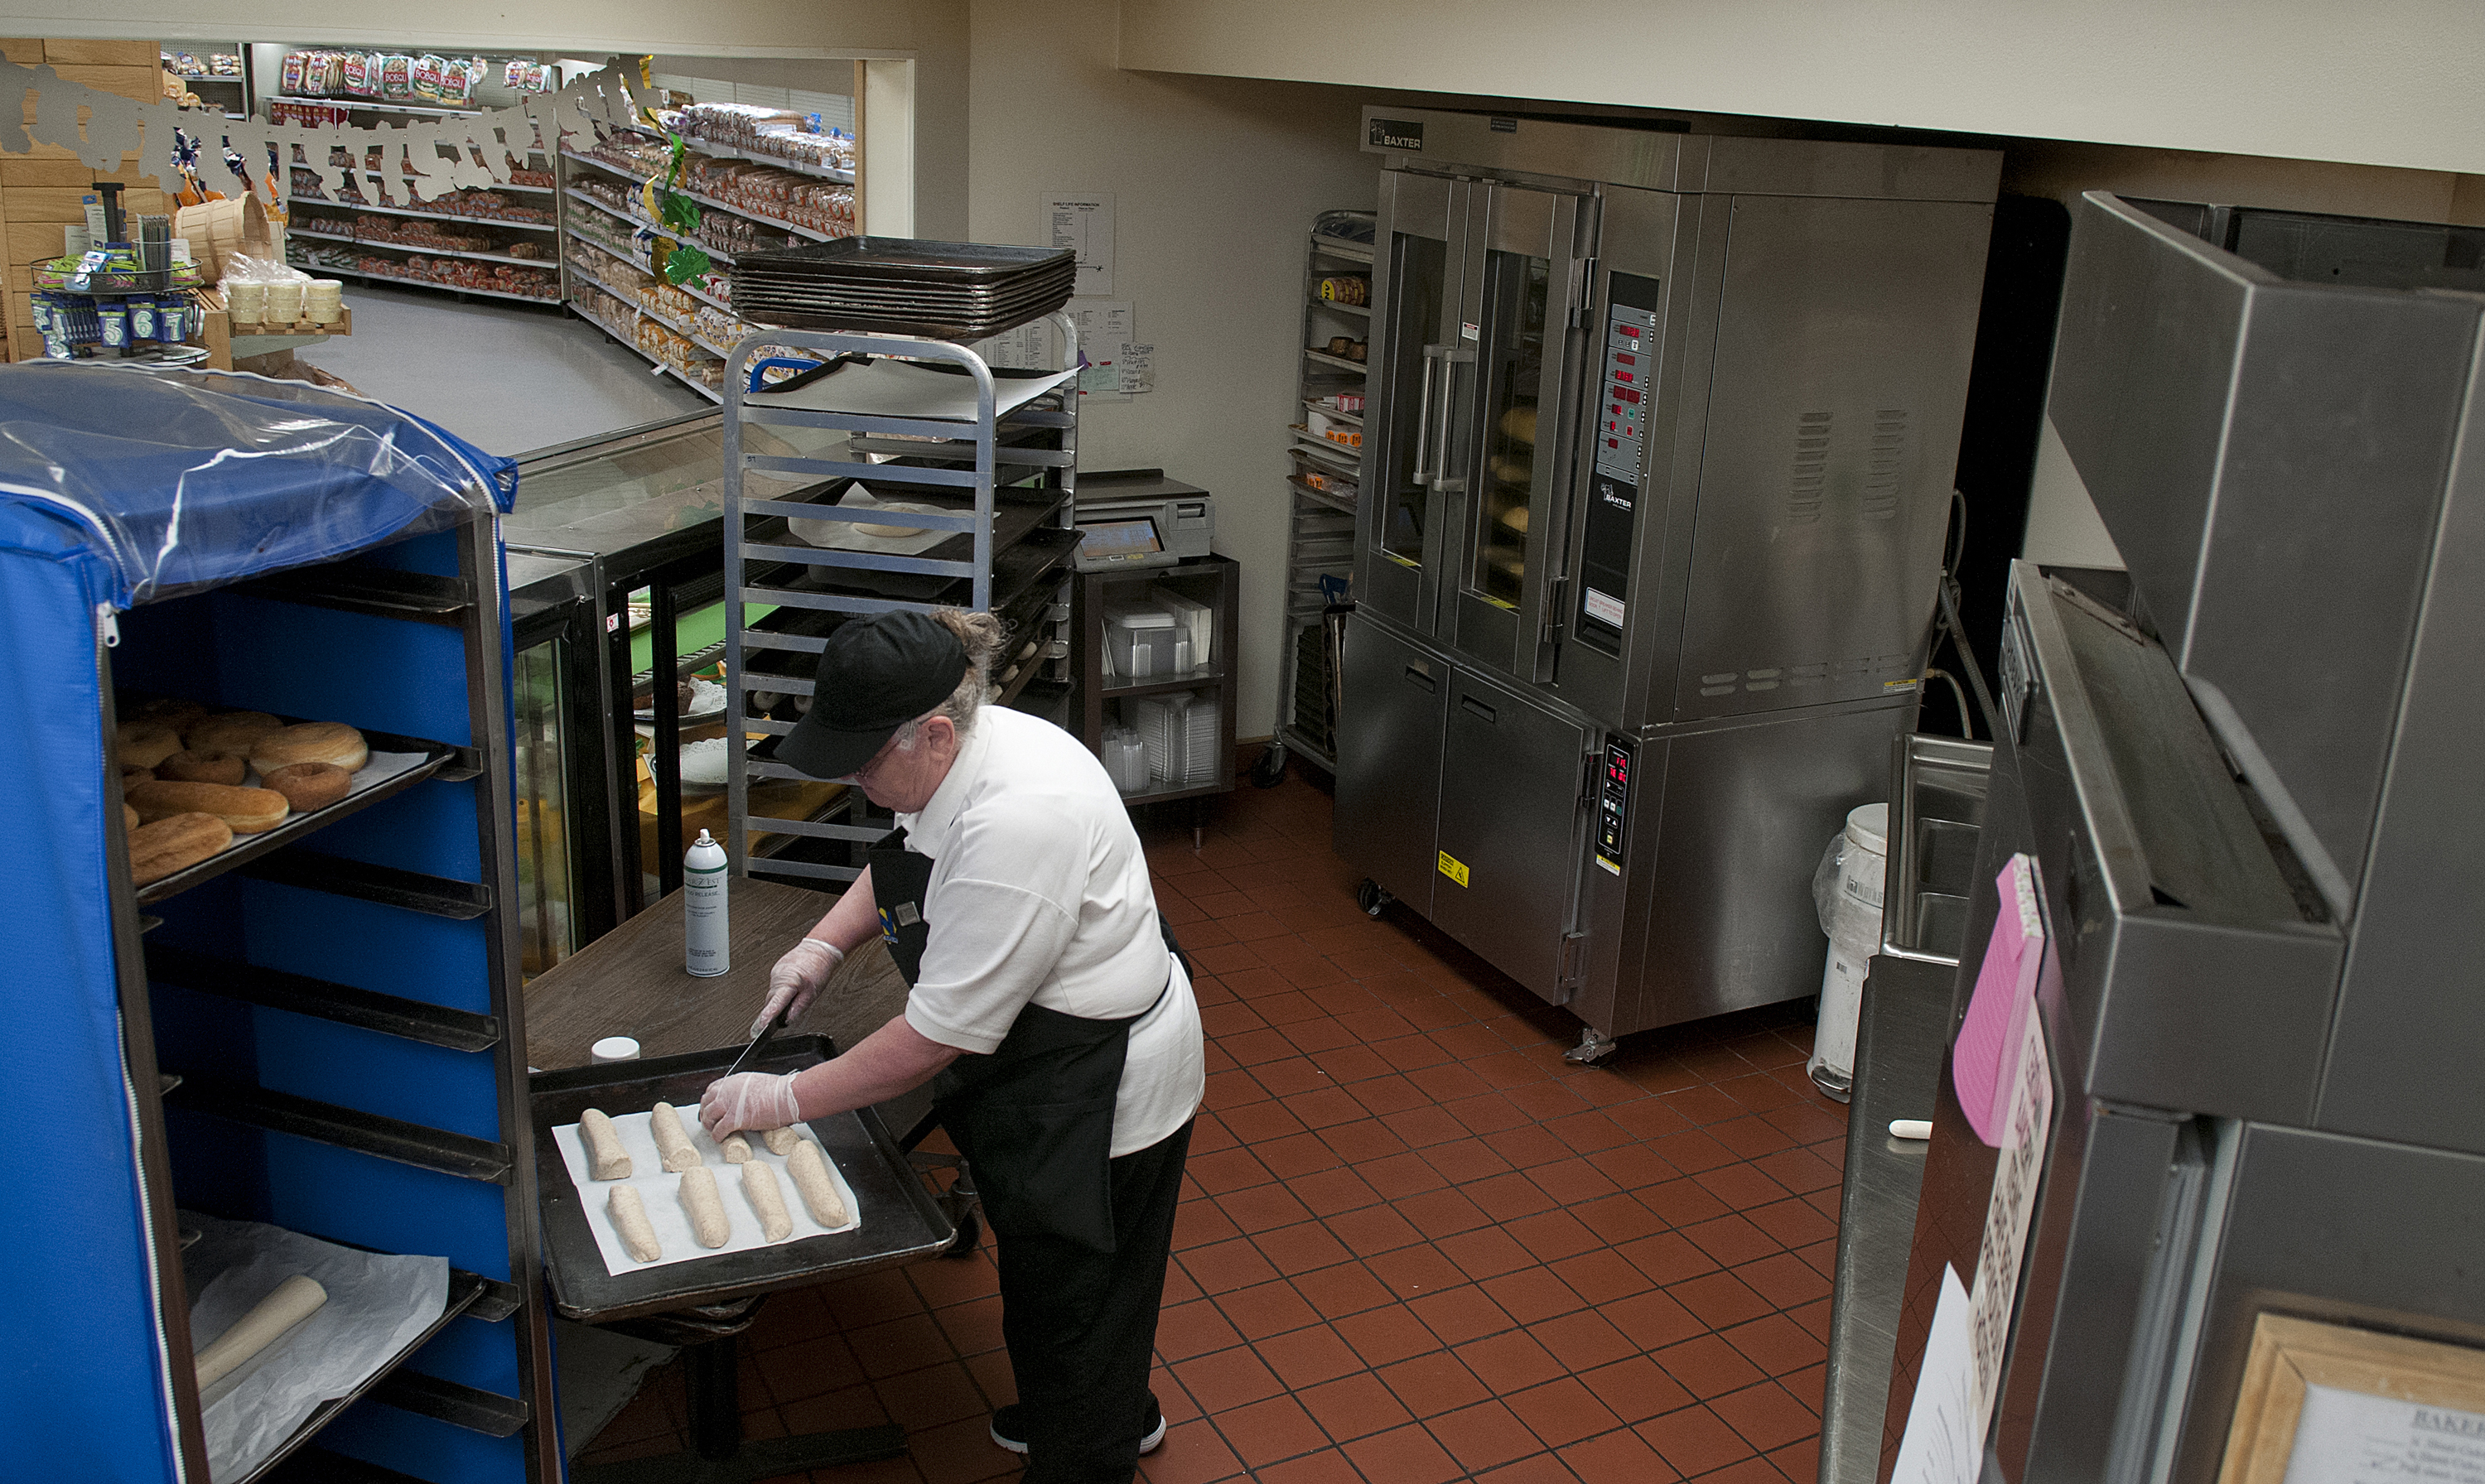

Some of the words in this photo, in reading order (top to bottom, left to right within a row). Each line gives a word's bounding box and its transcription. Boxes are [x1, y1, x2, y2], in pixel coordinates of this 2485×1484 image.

[1384, 135, 1421, 149] BAXTER
[104, 319, 123, 344] 5
[133, 311, 153, 337] 6
[165, 314, 183, 341] 7
[1605, 494, 1632, 508] BAXTER
